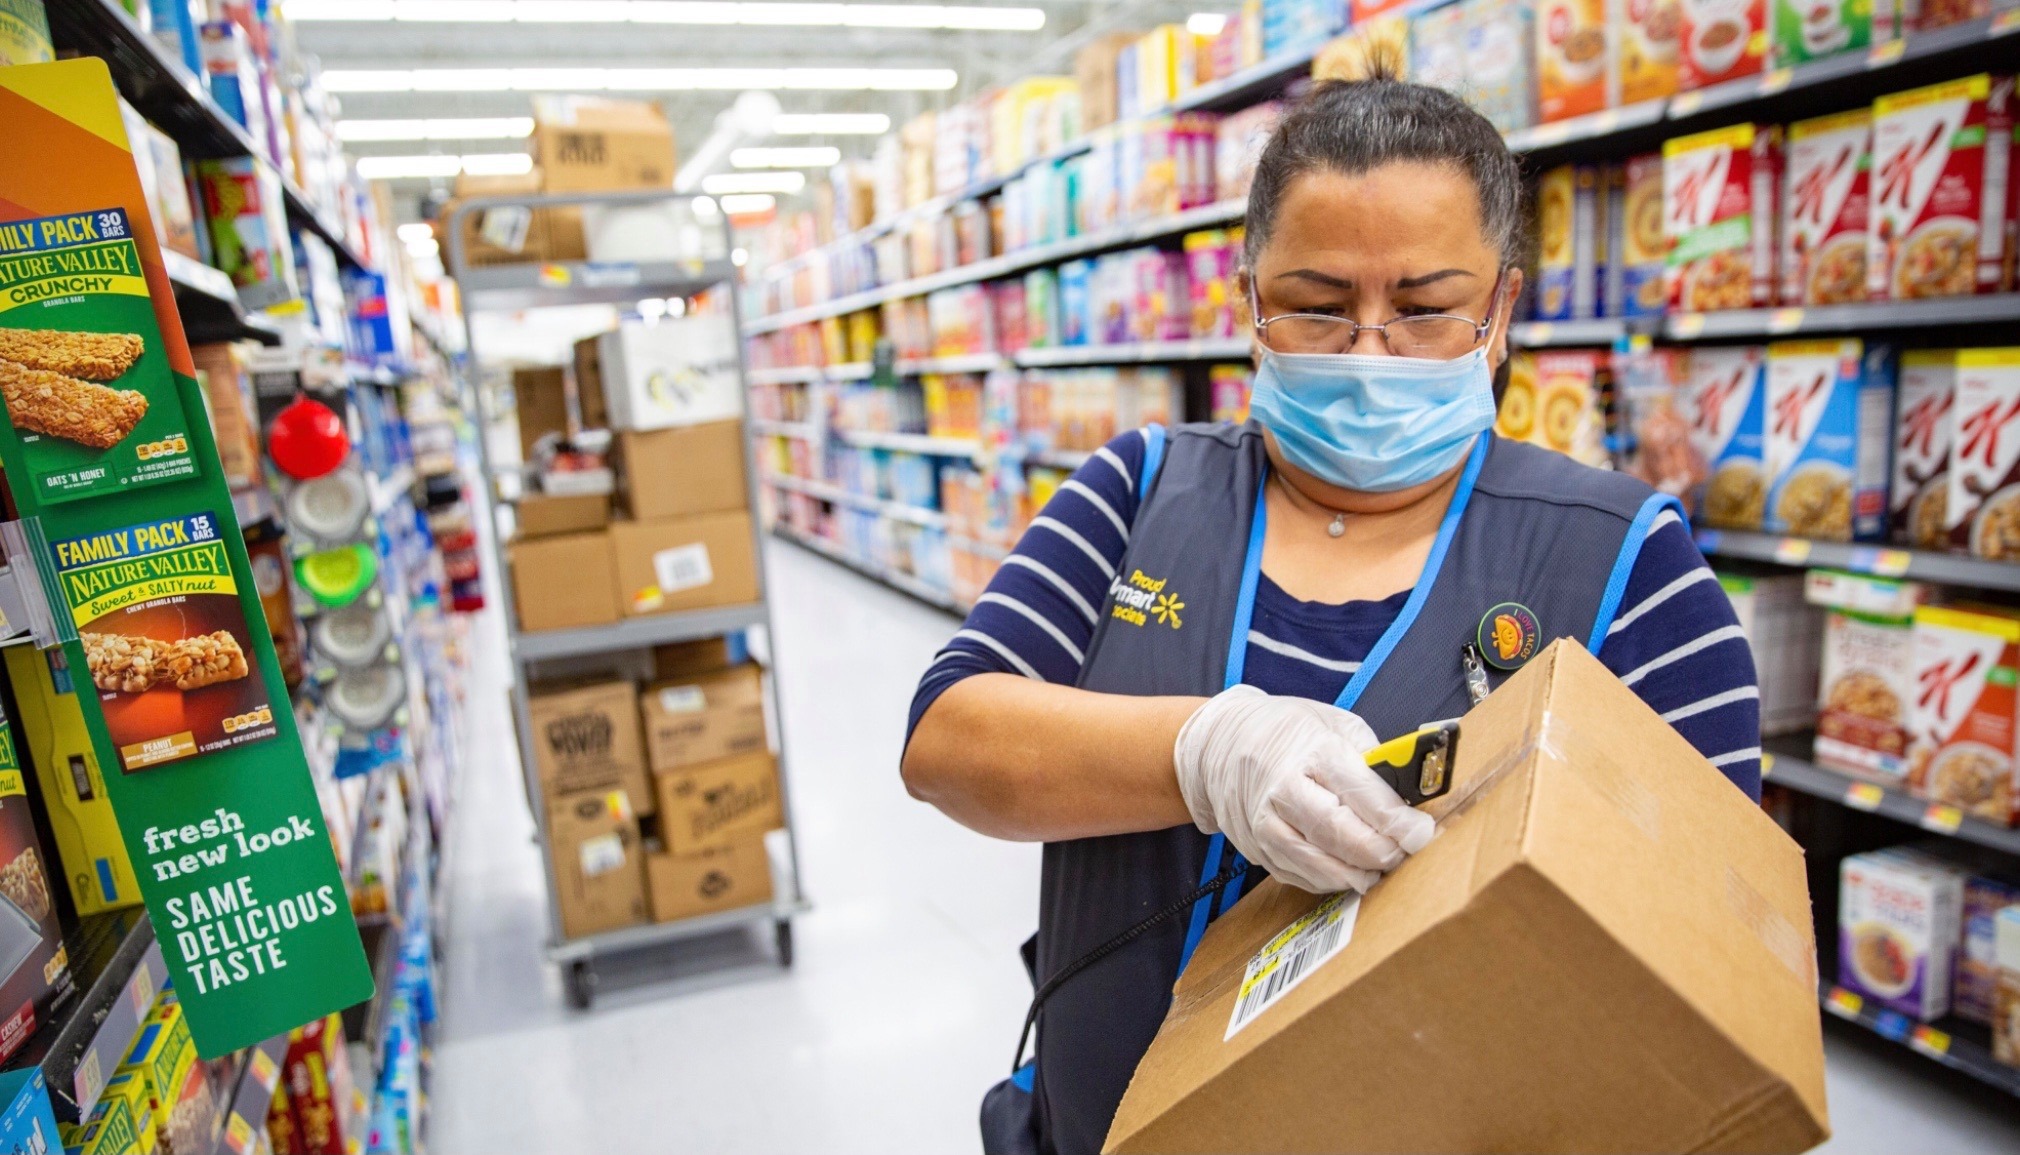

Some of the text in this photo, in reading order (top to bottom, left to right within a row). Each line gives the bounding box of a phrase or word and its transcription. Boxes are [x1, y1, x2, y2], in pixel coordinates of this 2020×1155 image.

[41, 214, 99, 246] PACK
[98, 212, 121, 228] 30
[102, 226, 125, 238] BARS
[55, 245, 131, 274] VALLEY
[10, 277, 113, 303] CRUNCHY
[70, 295, 85, 304] BARS
[46, 474, 68, 487] OATS
[79, 467, 105, 481] HONEY
[190, 516, 209, 530] 15
[192, 527, 214, 541] BARS
[56, 520, 190, 567] FAMILY PACK
[70, 546, 220, 604] NATURE VALLEY
[1129, 569, 1167, 593] Proud
[91, 590, 136, 616] Sweet
[149, 578, 185, 596] SALTY
[185, 578, 216, 592] nut
[146, 599, 171, 609] GRANOLA
[172, 595, 187, 604] BARS
[1109, 575, 1156, 610] lmart
[1112, 604, 1147, 627] ociate
[1518, 612, 1535, 632] LOVE
[1520, 632, 1535, 660] TACOS
[143, 738, 173, 753] PEANUT
[143, 807, 244, 855] fresh
[153, 815, 315, 882] new look
[165, 875, 259, 929] SAME
[176, 885, 338, 963] DELICIOUS
[187, 937, 288, 995] TASTE
